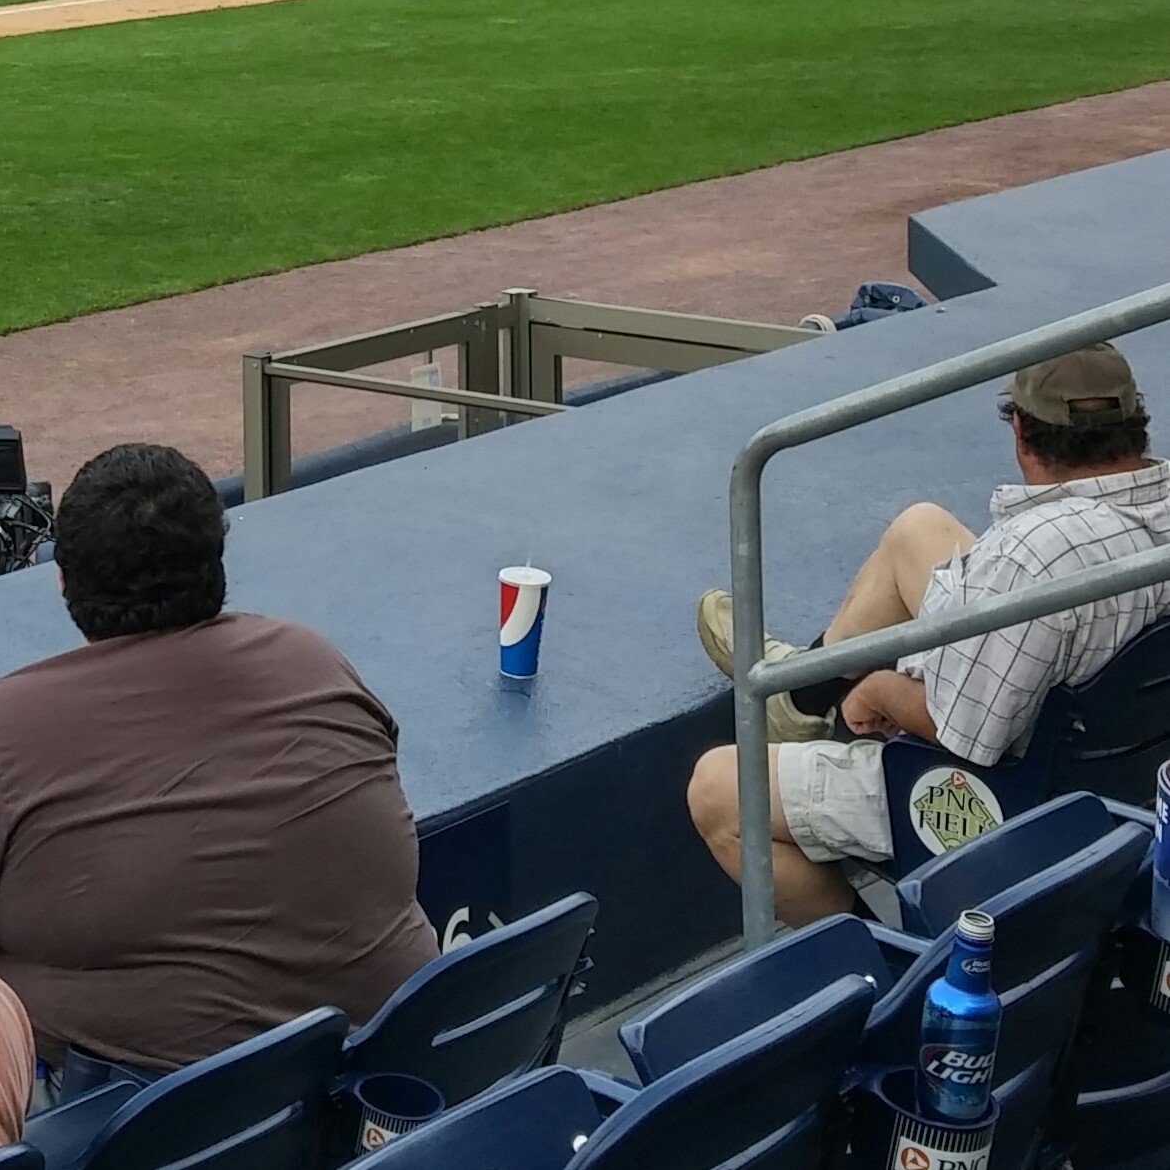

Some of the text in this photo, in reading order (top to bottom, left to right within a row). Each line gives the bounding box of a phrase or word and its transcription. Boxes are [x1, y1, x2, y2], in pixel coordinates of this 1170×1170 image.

[926, 785, 985, 819] PNC
[926, 1060, 993, 1085] LIGH
[941, 1050, 997, 1070] BUD
